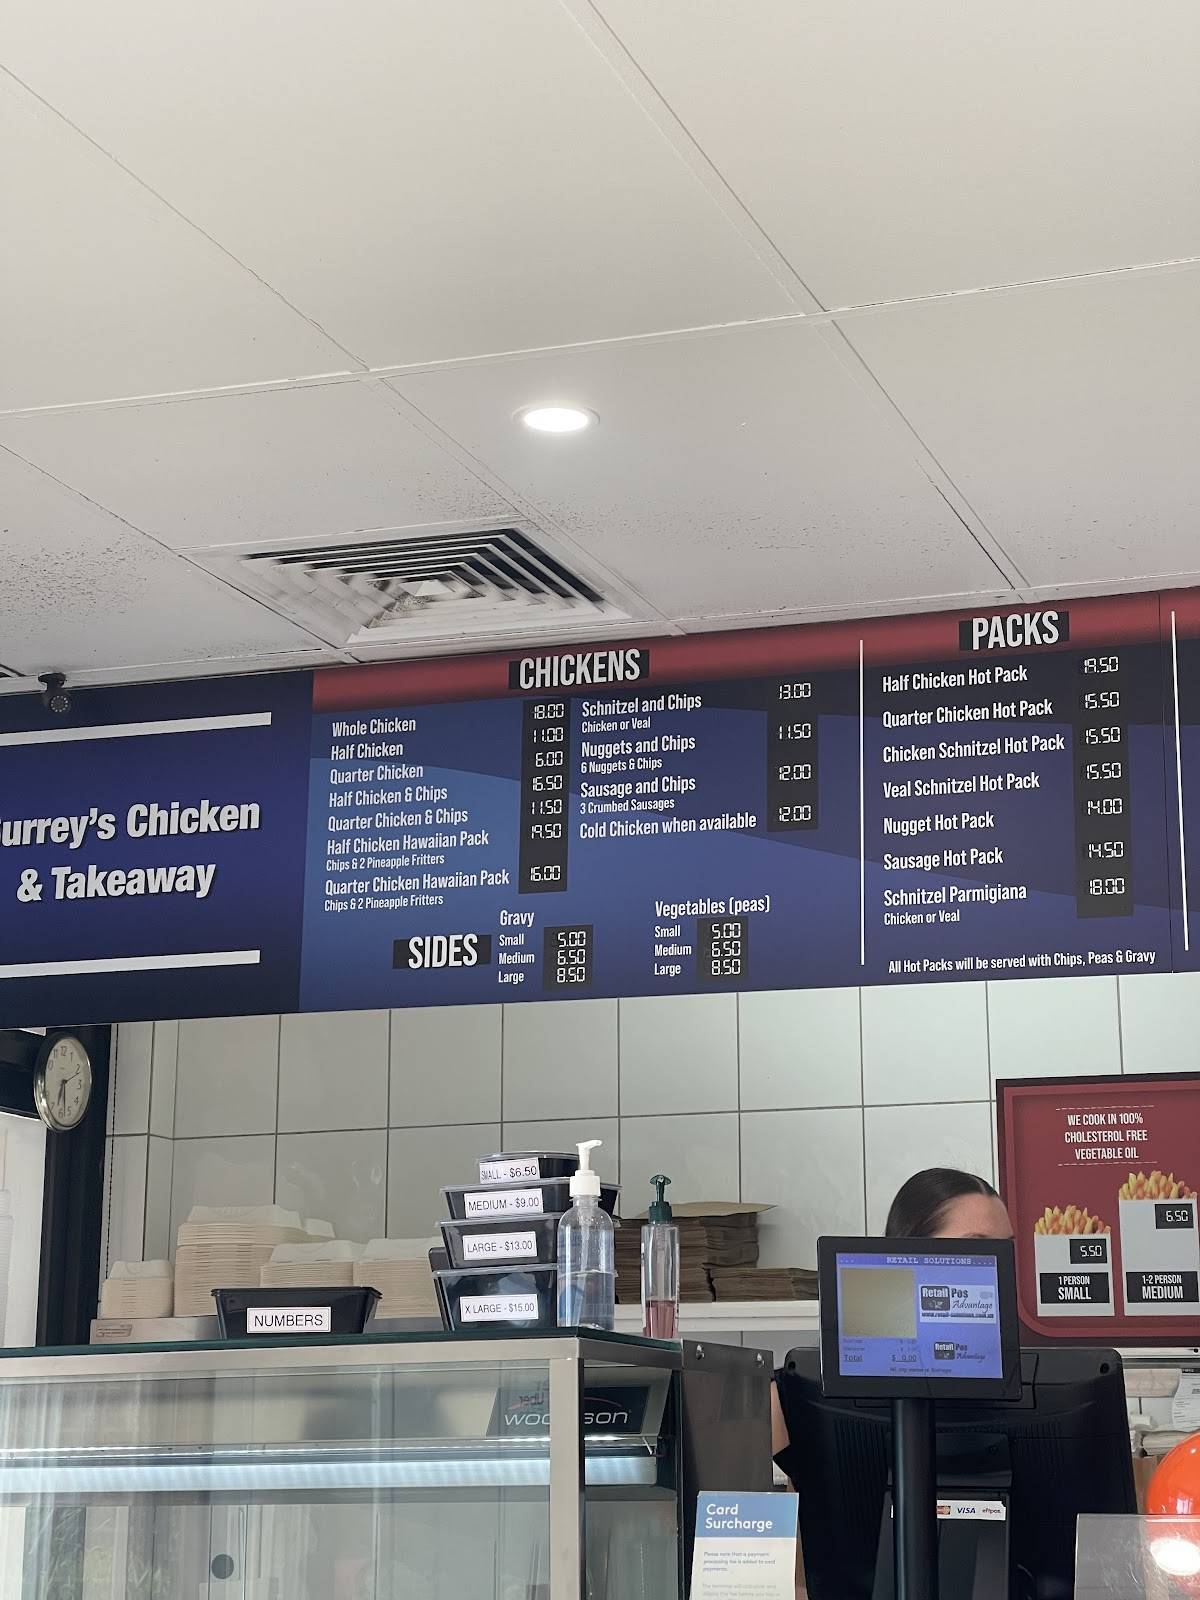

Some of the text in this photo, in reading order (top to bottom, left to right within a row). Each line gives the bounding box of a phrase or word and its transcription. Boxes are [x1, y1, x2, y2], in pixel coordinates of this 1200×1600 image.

[973, 611, 1058, 650] PACKS
[520, 649, 640, 689] CHICKENS
[883, 665, 1027, 692] Half Chicken Hot Pack
[779, 683, 811, 699] 13.00
[583, 694, 701, 717] Schnitzel and Chips
[1085, 692, 1119, 709] 15.50
[532, 704, 564, 719] 18.00
[883, 699, 1052, 728] Quarter Chicken Hot Pack
[333, 718, 415, 737] Whole Chicken
[582, 716, 650, 733] Chicken Veal
[780, 724, 811, 739] 11.50
[534, 727, 563, 742] 11.00
[1086, 727, 1120, 744] 15.50
[331, 742, 403, 760] Half Chicken
[582, 735, 695, 759] Nuggets and Chips
[884, 734, 1064, 762] Chicken Schnitzel Hot Pack
[536, 751, 563, 767] 6.00
[589, 757, 662, 774] Nuggets Chips
[330, 764, 423, 784] Quarter Chicken
[780, 764, 811, 780] 12.00
[1087, 763, 1121, 779] 15.50
[533, 775, 562, 791] 16.50
[581, 776, 695, 798] Sausage and Chips
[884, 772, 1040, 798] Veal Schnitzel Hot Pack
[329, 786, 447, 807] Half Chicken Chips
[532, 799, 562, 814] 11.50
[588, 799, 674, 813] Crumbed Sausages
[779, 805, 811, 821] 12.00
[1088, 798, 1122, 815] 14.00
[0, 800, 259, 849] urrey’s Chicken
[328, 808, 468, 832] Quarter Chicken Chips
[580, 812, 756, 838] Cold Chicken when available
[884, 812, 994, 836] Nugget Hot Pack
[328, 830, 488, 855] Half Chicken Hawaiian Pack
[1089, 842, 1123, 858] 14.50
[326, 854, 444, 872] Chips Pineapple Fritters
[884, 847, 1003, 871] Sausage Hot Pack
[531, 866, 560, 881] 16.00
[17, 864, 216, 902] & Takeaway
[326, 869, 509, 896] Quarter Chicken Hawaiian Pack
[1090, 878, 1124, 895] 18.00
[884, 884, 1026, 906] Schnitzel Parmigiana
[656, 895, 769, 919] Vegetables (peas)
[500, 910, 534, 927] Gravy
[884, 909, 959, 925] Chicken Veal
[499, 931, 586, 947] Small 5.00
[655, 923, 740, 939] Small 5.00
[409, 934, 477, 968] SIDES
[499, 949, 585, 965] Medium 6.50
[655, 941, 740, 957] Medium 6.50
[655, 959, 740, 976] Large 8.50
[889, 950, 1155, 973] All Hot Packs will be served with Chips, Peas Gravy
[499, 967, 585, 984] Large 8.50
[1068, 1113, 1143, 1125] WE COOK IN 100%
[1065, 1130, 1147, 1143] CHOLESTEROL FREE
[1075, 1147, 1139, 1159] VEGETABLE OIL
[510, 1166, 536, 1177] $6.50
[469, 1198, 538, 1210] MEDIUM $9.00
[1166, 1210, 1188, 1221] 6.50
[468, 1241, 532, 1252] LARGE $13.00
[1080, 1246, 1102, 1257] 5.50
[1064, 1276, 1090, 1285] PERSON
[1142, 1275, 1181, 1284] 1-2 PERSON
[922, 1288, 968, 1298] Retail Pos
[1058, 1287, 1091, 1299] SMALL
[1142, 1286, 1183, 1299] MEDIUM
[474, 1303, 534, 1313] LARGE $15.00
[255, 1315, 322, 1326] NUMBERS
[707, 1504, 738, 1515] Card
[706, 1518, 772, 1532] Surcharge
